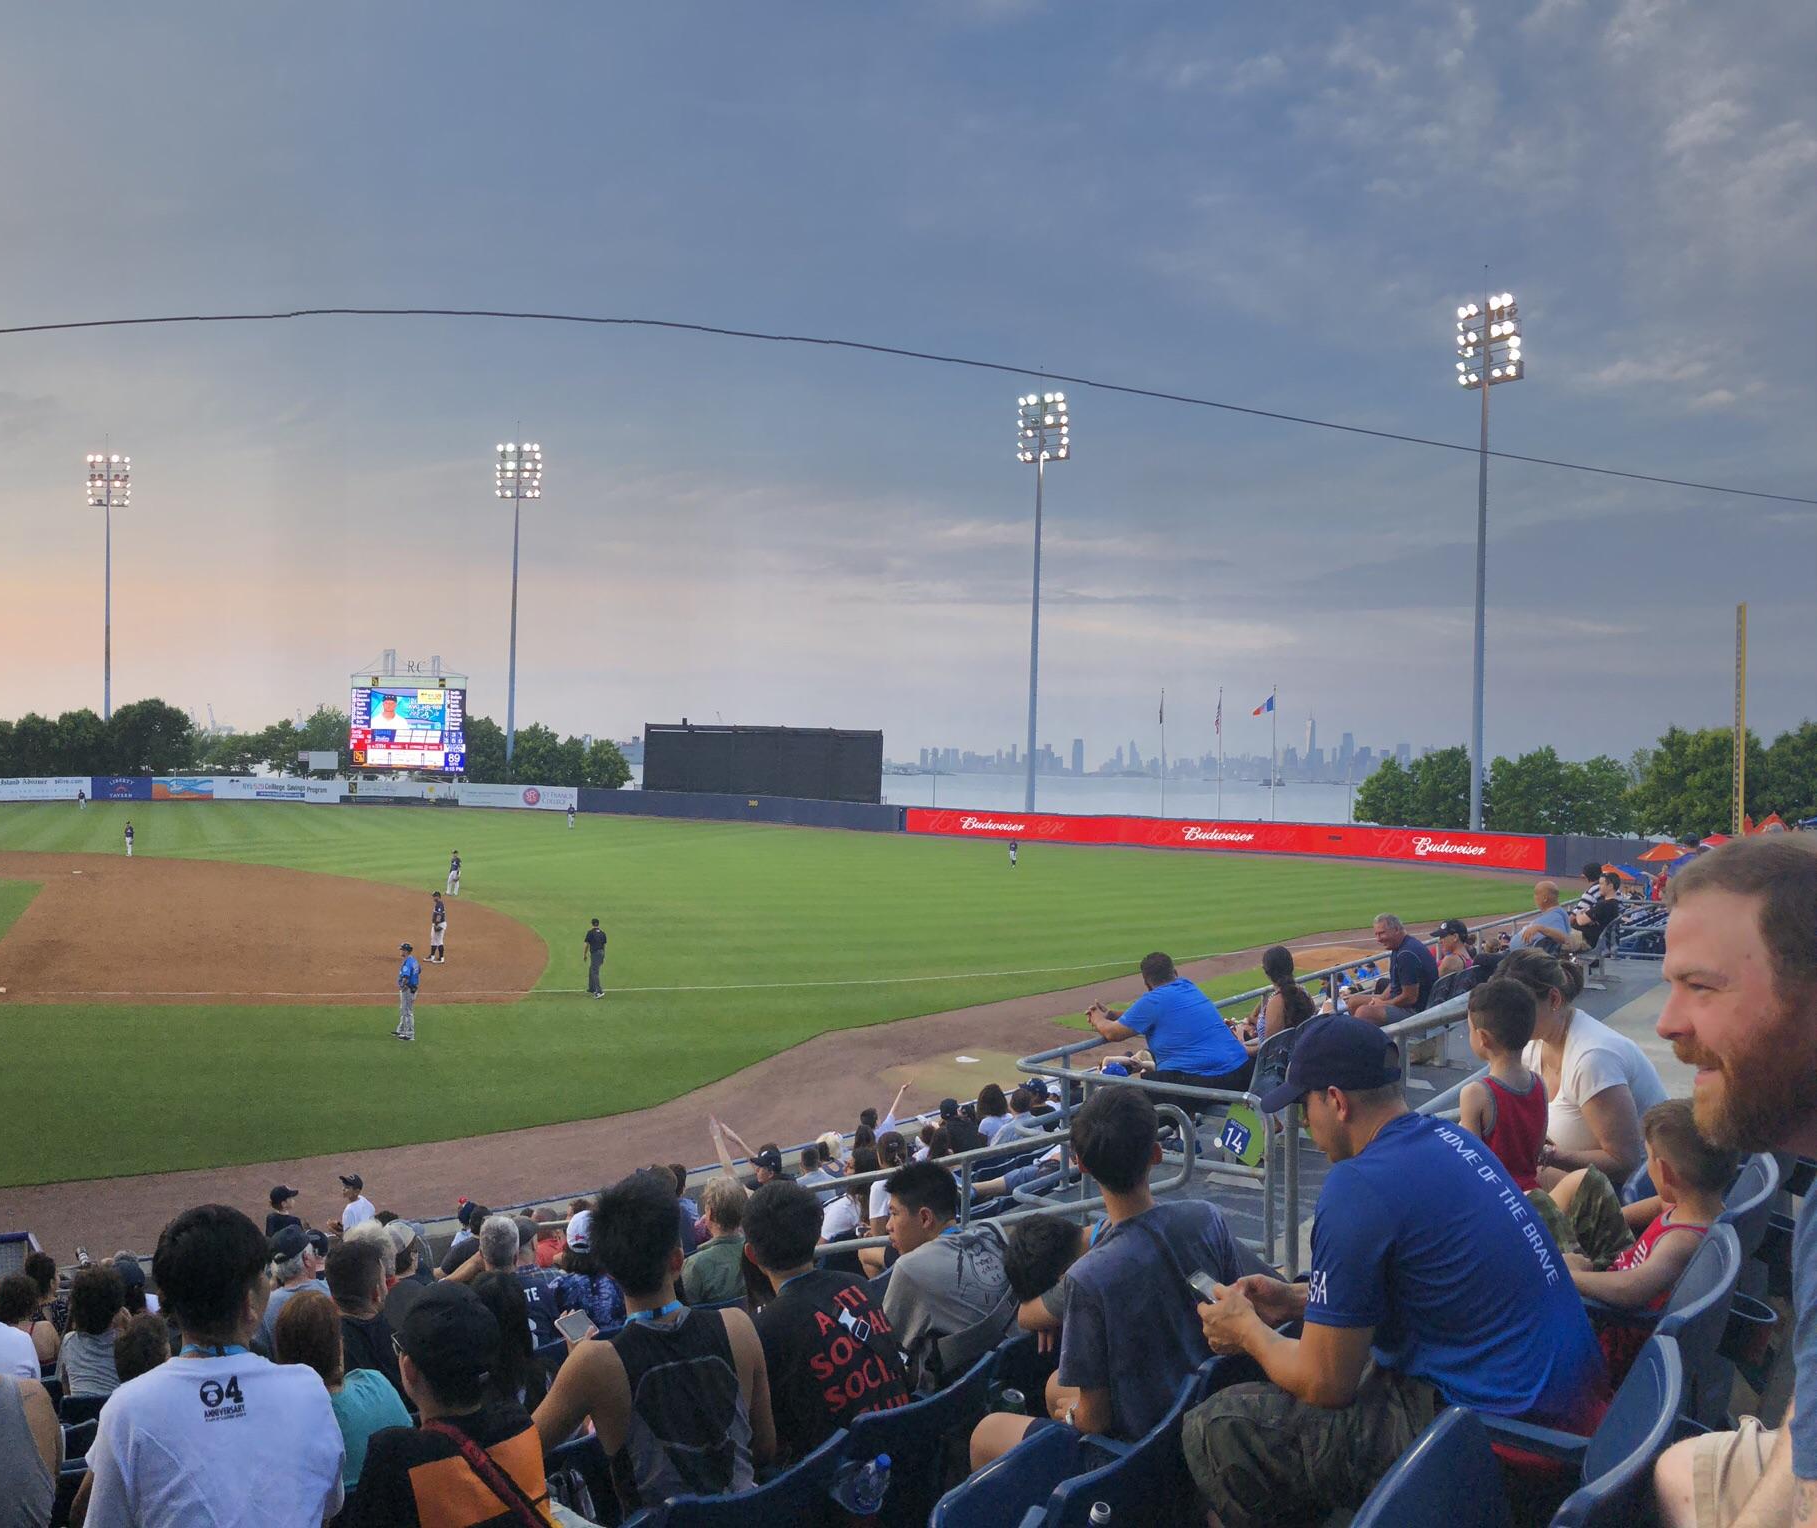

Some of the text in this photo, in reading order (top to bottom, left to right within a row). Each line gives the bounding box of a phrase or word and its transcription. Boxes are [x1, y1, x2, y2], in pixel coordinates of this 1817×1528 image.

[448, 753, 461, 763] 89
[265, 783, 285, 793] College
[287, 783, 306, 793] Savings
[306, 786, 328, 795] Program
[960, 815, 1026, 833] Budweiser
[1181, 826, 1255, 843] Budweiser
[1412, 836, 1487, 855] Budweiser
[1229, 1117, 1250, 1134] SECTION
[1225, 1126, 1243, 1154] 14
[1433, 1126, 1560, 1287] HOME OF THE BRAVE
[204, 1404, 245, 1418] ANNIVERSARY
